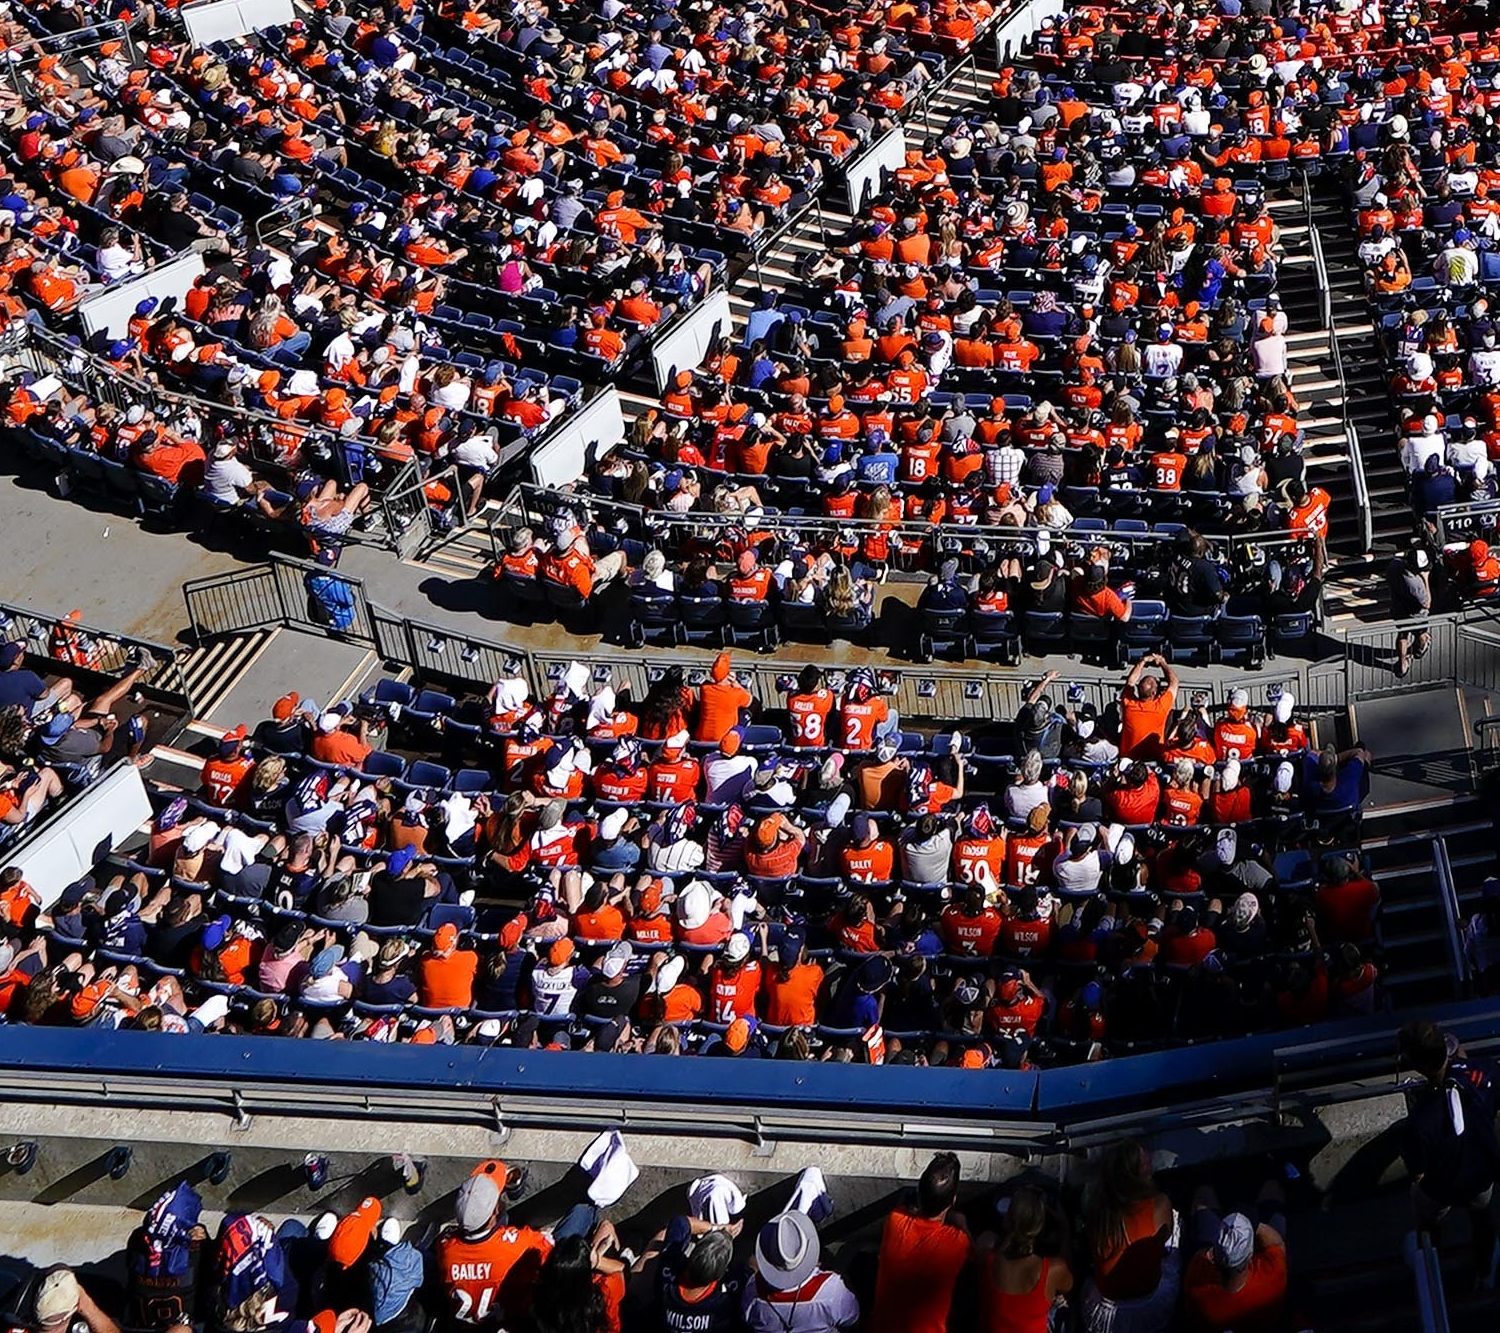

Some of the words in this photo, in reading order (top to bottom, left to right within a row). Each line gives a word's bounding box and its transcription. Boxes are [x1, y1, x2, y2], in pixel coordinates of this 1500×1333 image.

[1447, 518, 1473, 530] 110
[792, 713, 821, 740] 58
[847, 718, 861, 744] 2
[960, 860, 990, 882] 30
[957, 928, 982, 938] WILSON
[1014, 930, 1039, 942] WILSON
[542, 995, 559, 1013] 7
[451, 1262, 491, 1280] BAILEY
[666, 1311, 710, 1330] WILSON
